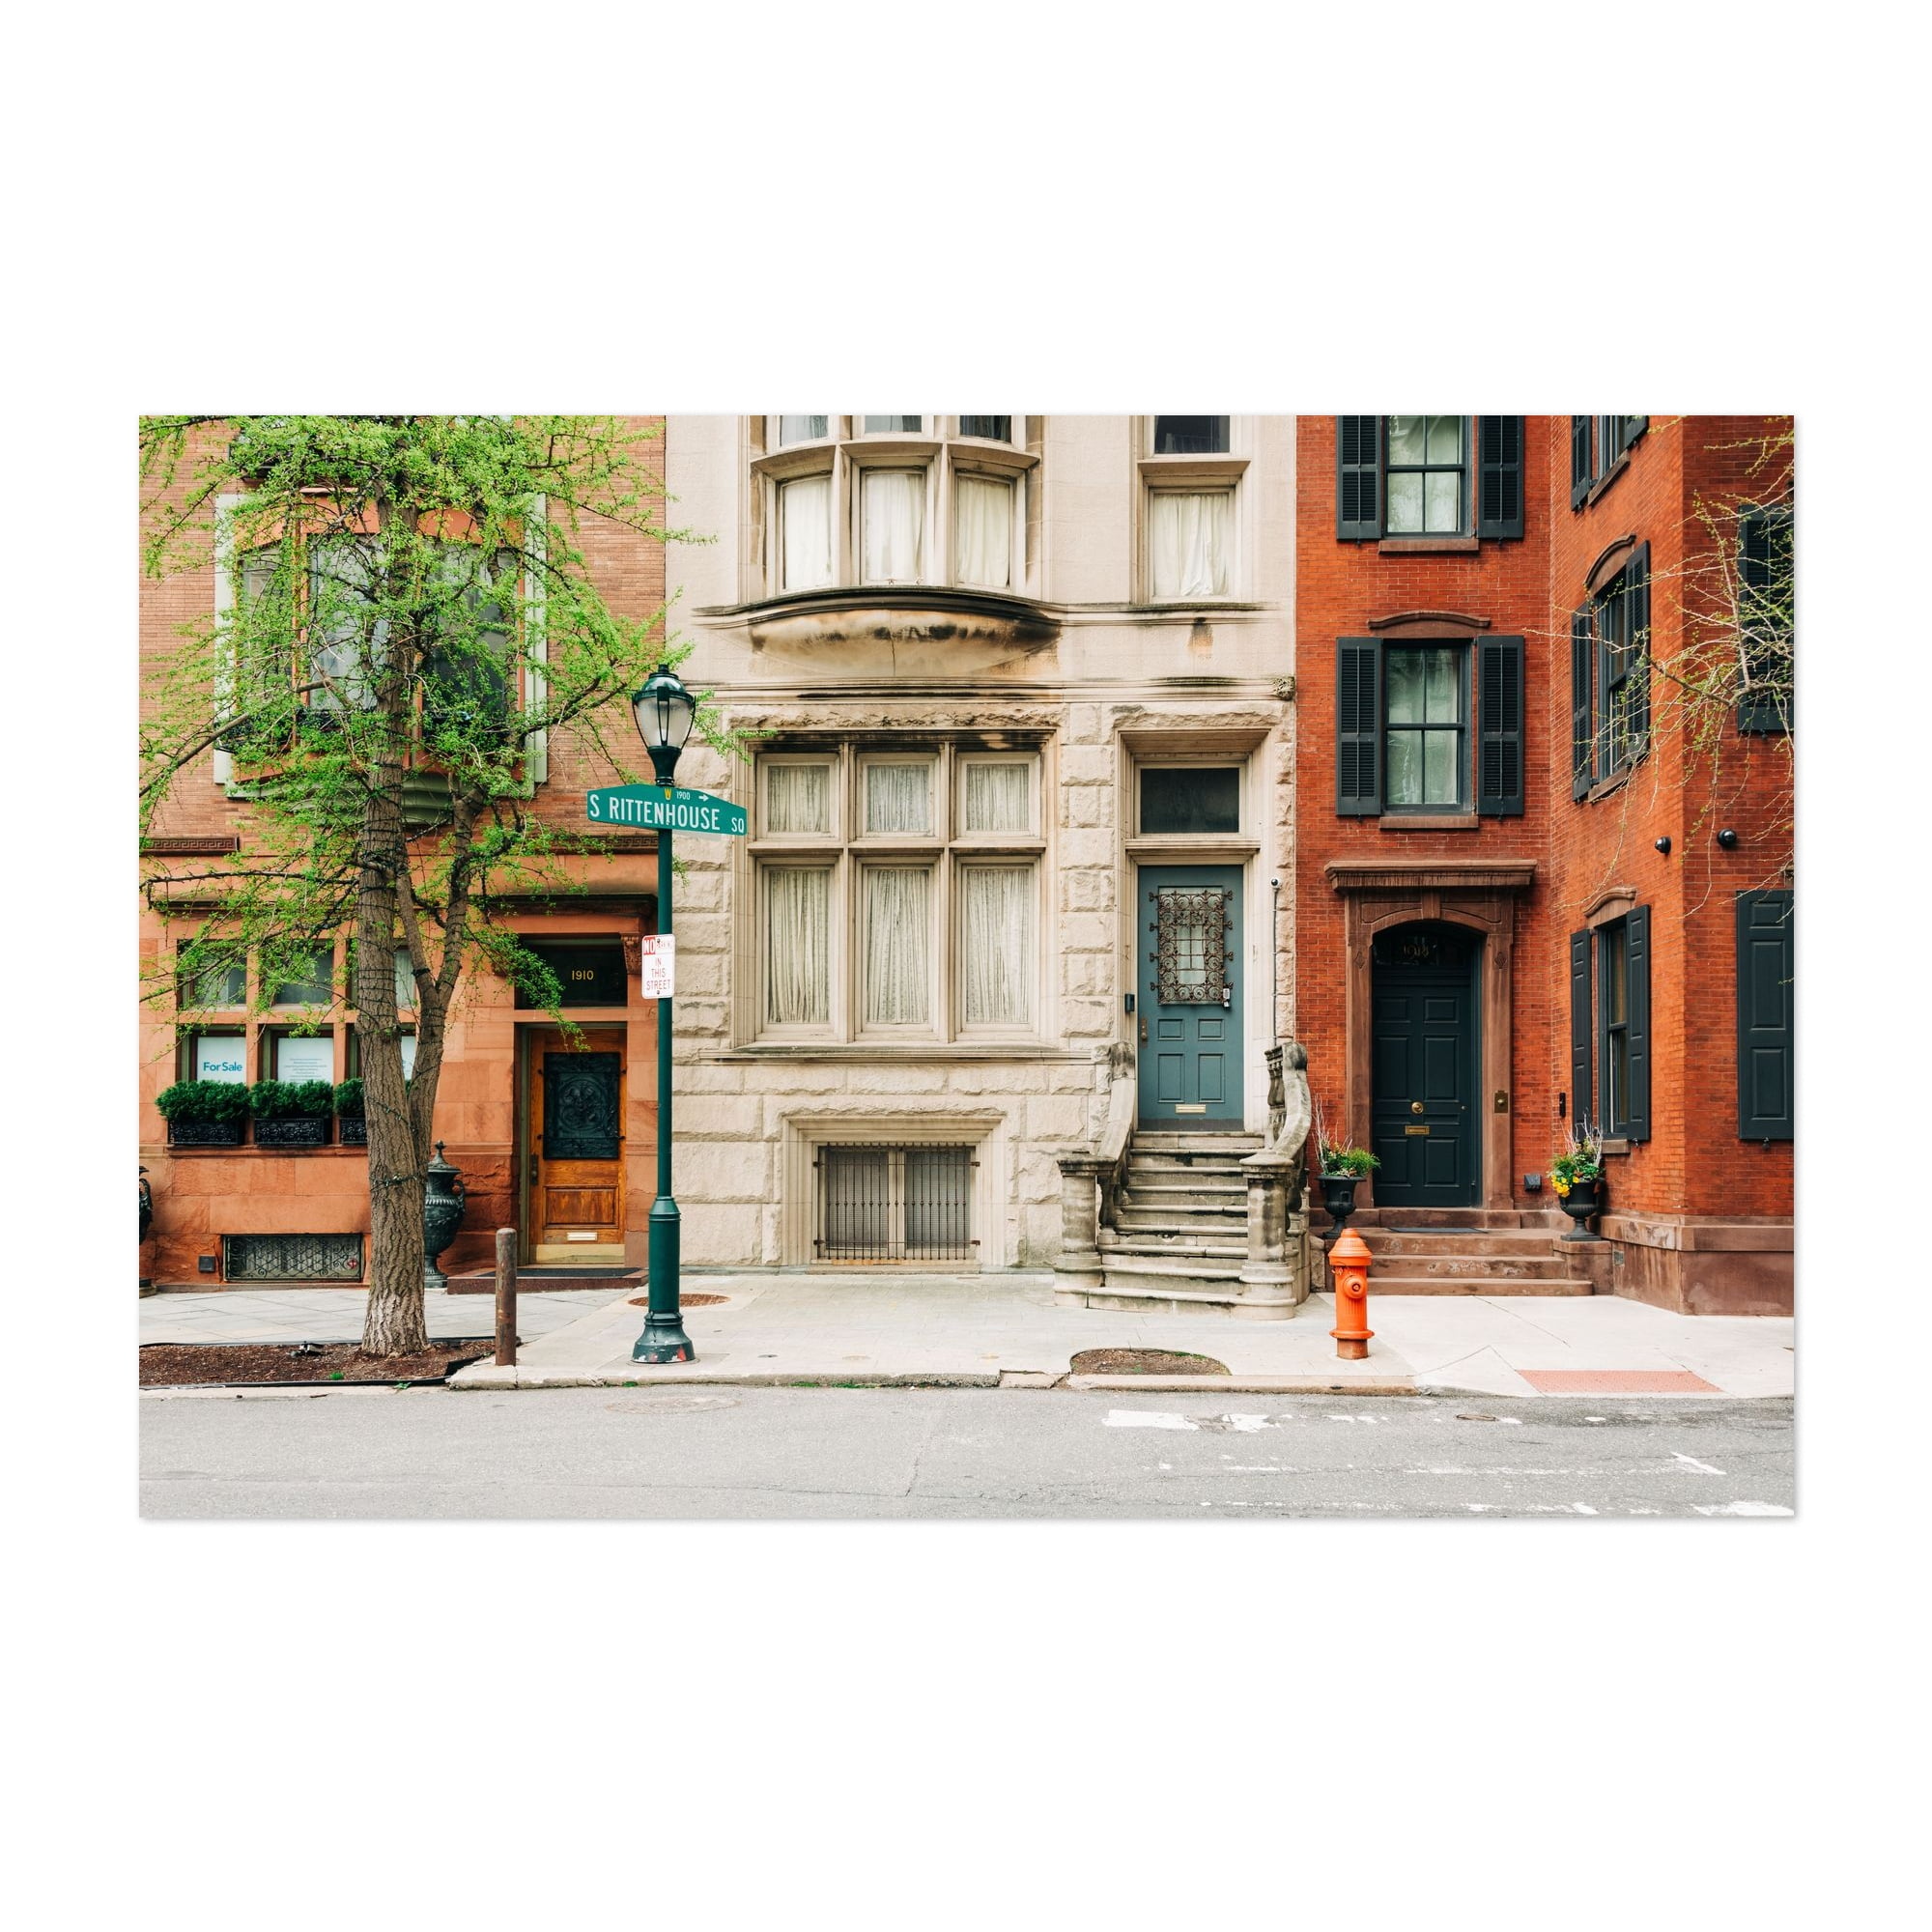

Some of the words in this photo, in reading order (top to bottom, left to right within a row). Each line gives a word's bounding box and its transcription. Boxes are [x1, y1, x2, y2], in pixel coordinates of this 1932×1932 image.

[676, 791, 691, 801] 1900
[589, 794, 600, 817] S
[609, 797, 721, 831] RITTENHOUSE
[731, 817, 745, 834] SQ
[643, 938, 656, 954] NO
[655, 957, 662, 966] IN
[572, 970, 594, 980] 1910
[651, 968, 667, 978] THIS
[646, 979, 671, 990] STREET
[203, 1062, 221, 1071] For
[222, 1061, 242, 1071] Sale
